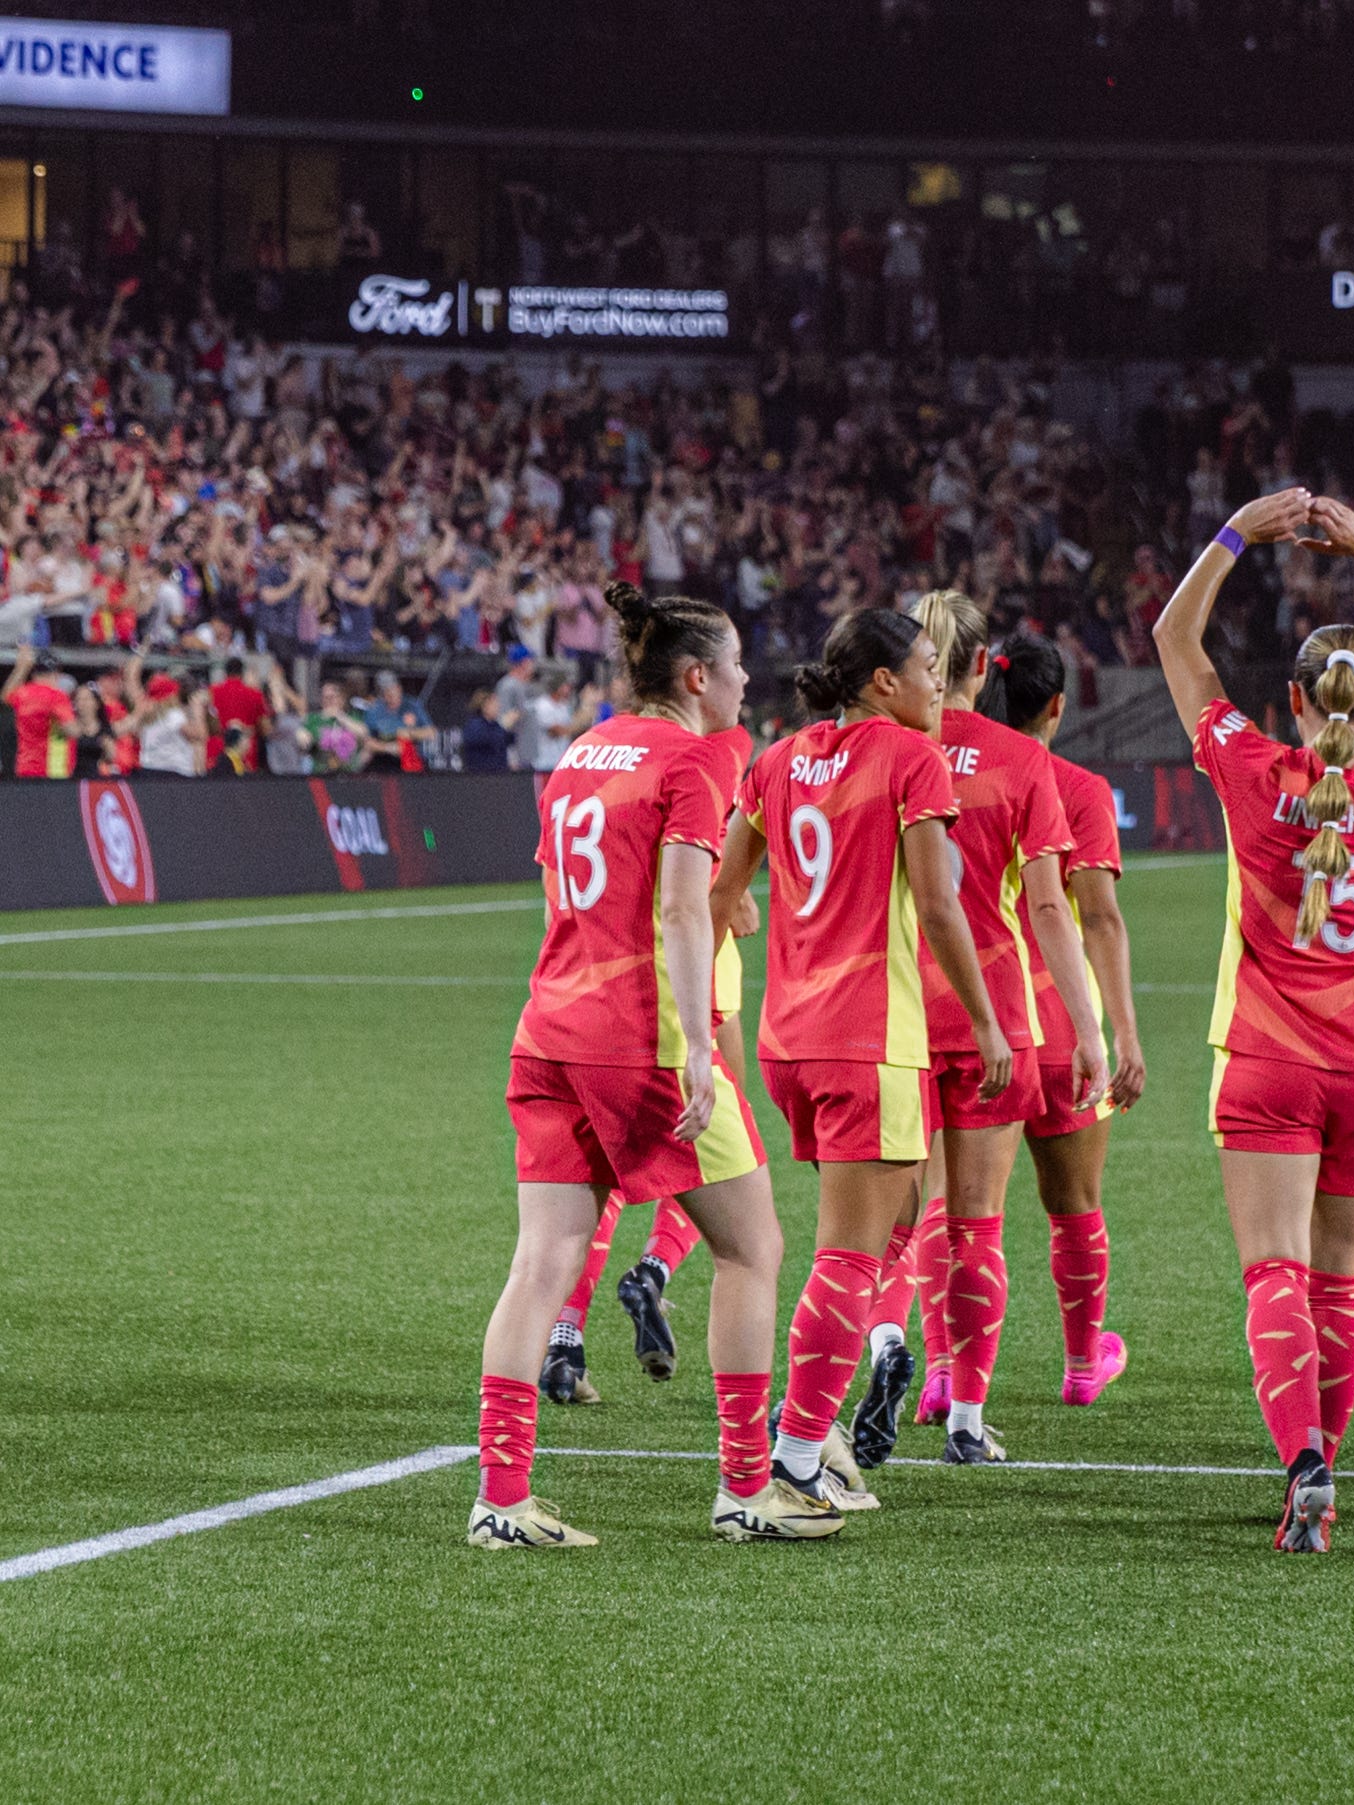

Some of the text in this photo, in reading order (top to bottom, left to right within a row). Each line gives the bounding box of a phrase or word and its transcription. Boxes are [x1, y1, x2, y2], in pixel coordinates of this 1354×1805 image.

[348, 273, 454, 337] Ford
[555, 744, 650, 772] MOULTRIE
[790, 749, 849, 786] SMITH
[326, 803, 389, 856] GOAL
[551, 794, 608, 912] 13
[789, 804, 834, 918] 9
